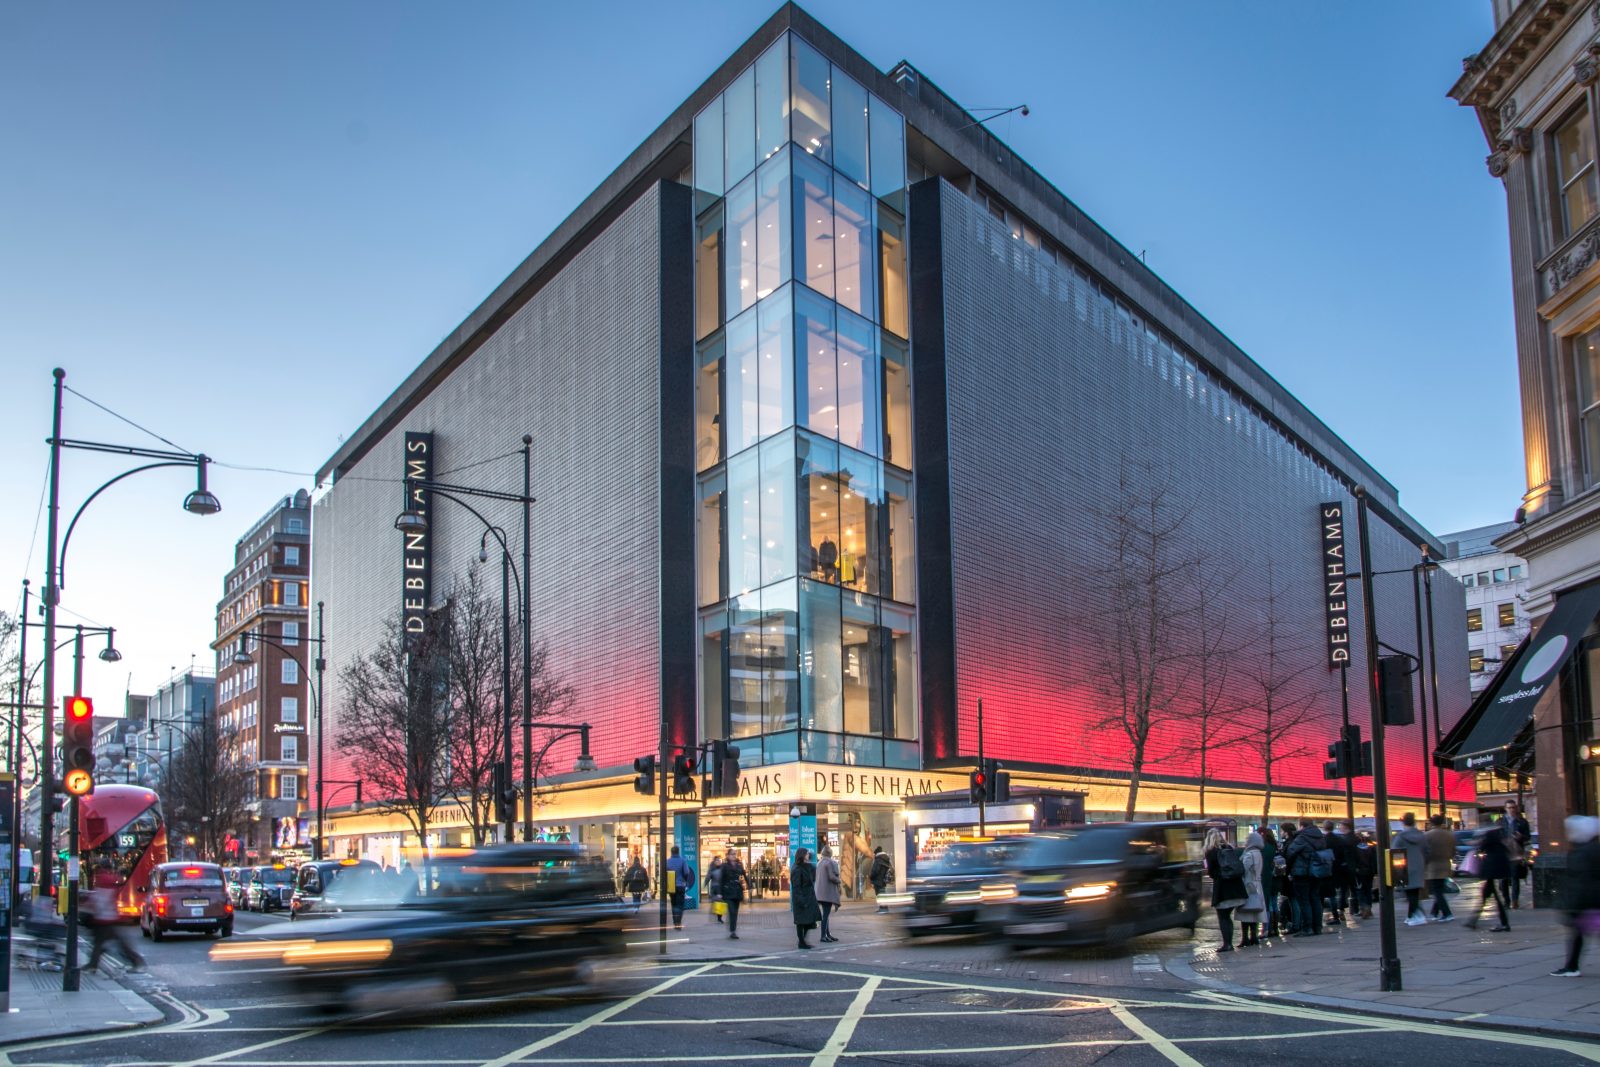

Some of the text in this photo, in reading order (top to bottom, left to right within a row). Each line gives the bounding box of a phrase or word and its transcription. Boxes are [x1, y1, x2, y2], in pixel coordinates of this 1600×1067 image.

[406, 440, 427, 633] DEBENAMS
[1324, 507, 1348, 662] DEBENHAMS
[814, 771, 944, 797] DEBENHAMS
[1296, 802, 1333, 814] DEBENHAMS
[119, 835, 134, 847] 159
